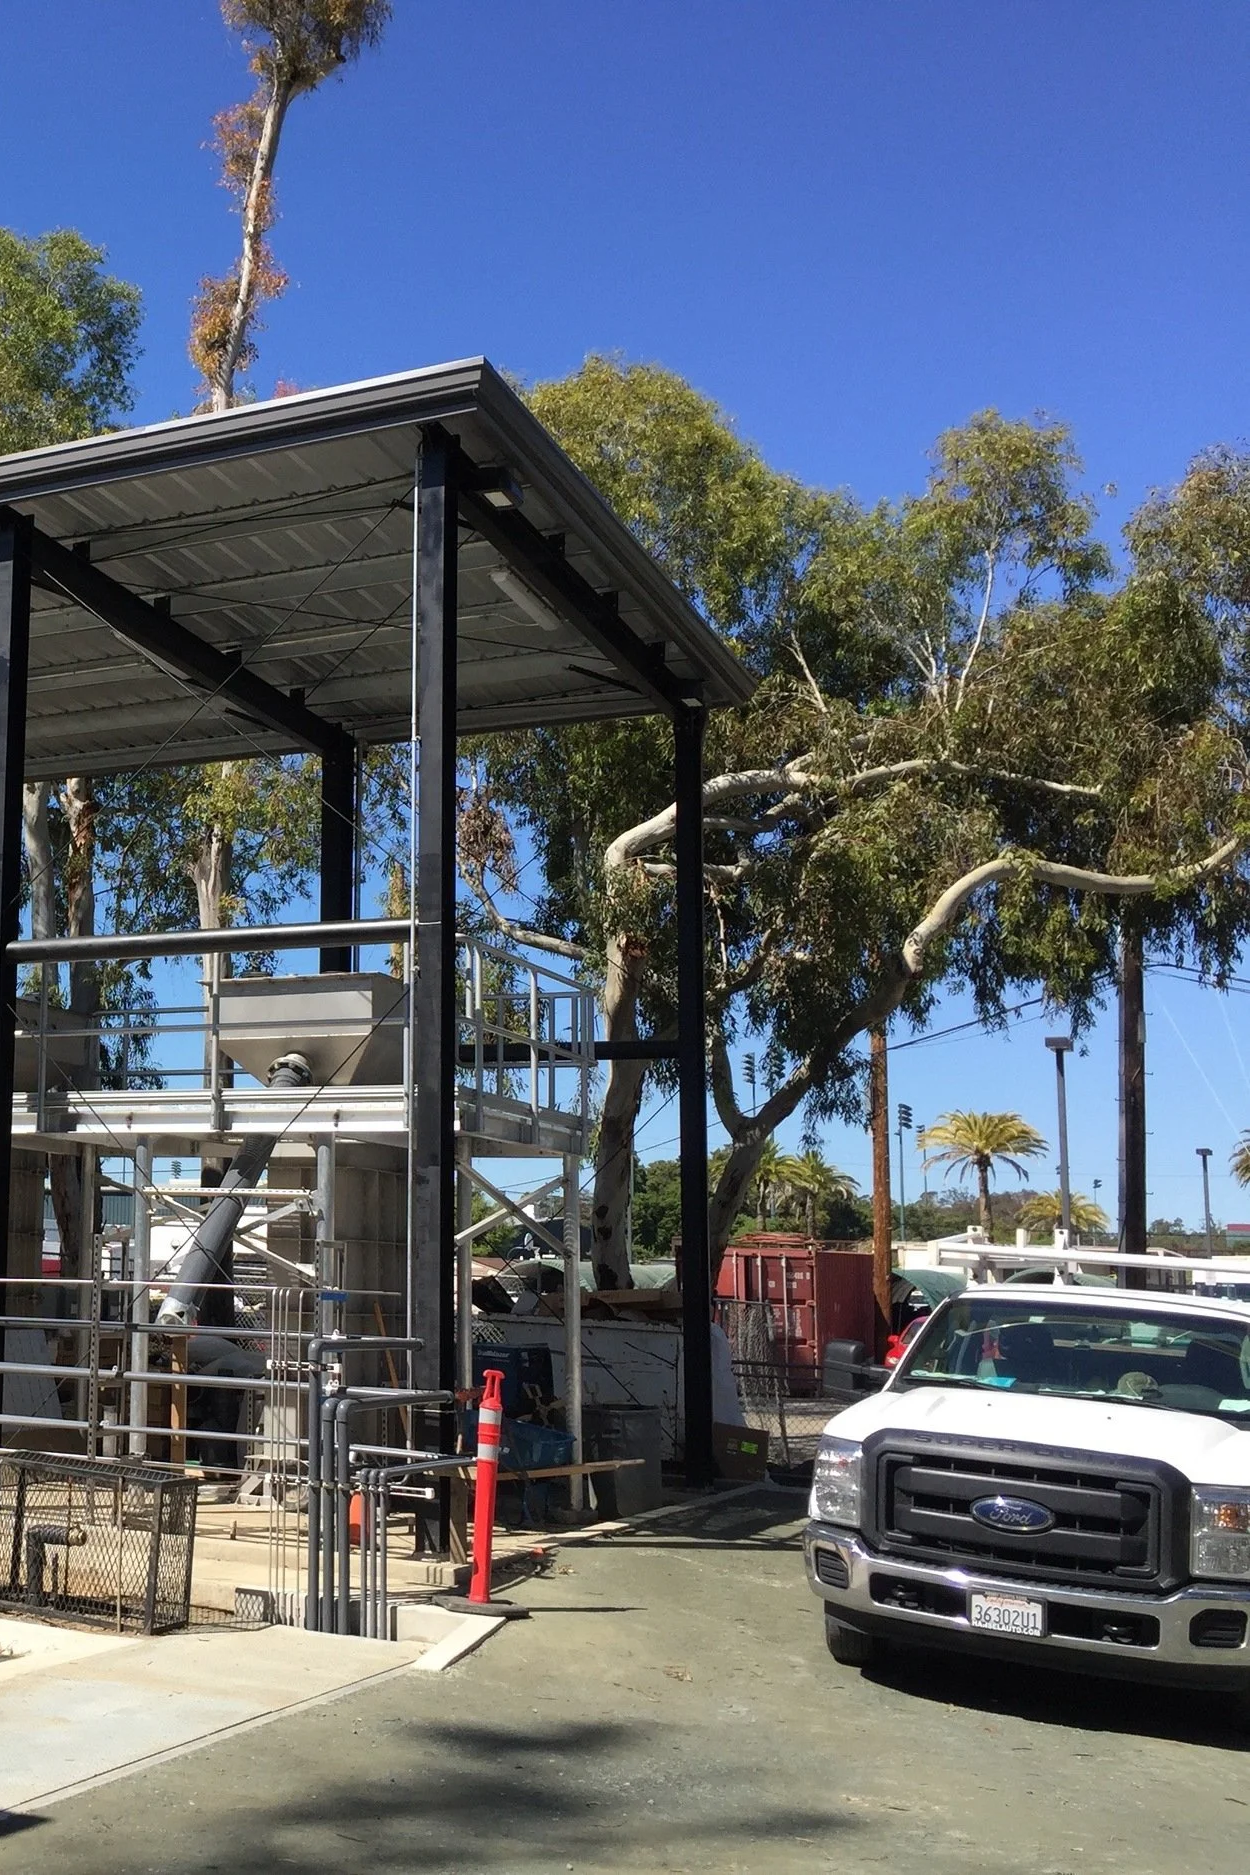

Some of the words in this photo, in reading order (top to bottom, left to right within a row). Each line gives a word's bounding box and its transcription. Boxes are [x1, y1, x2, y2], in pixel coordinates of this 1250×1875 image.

[913, 1434, 1018, 1451] SUPER
[988, 1502, 1031, 1525] Ford
[974, 1603, 1040, 1631] 36302U1
